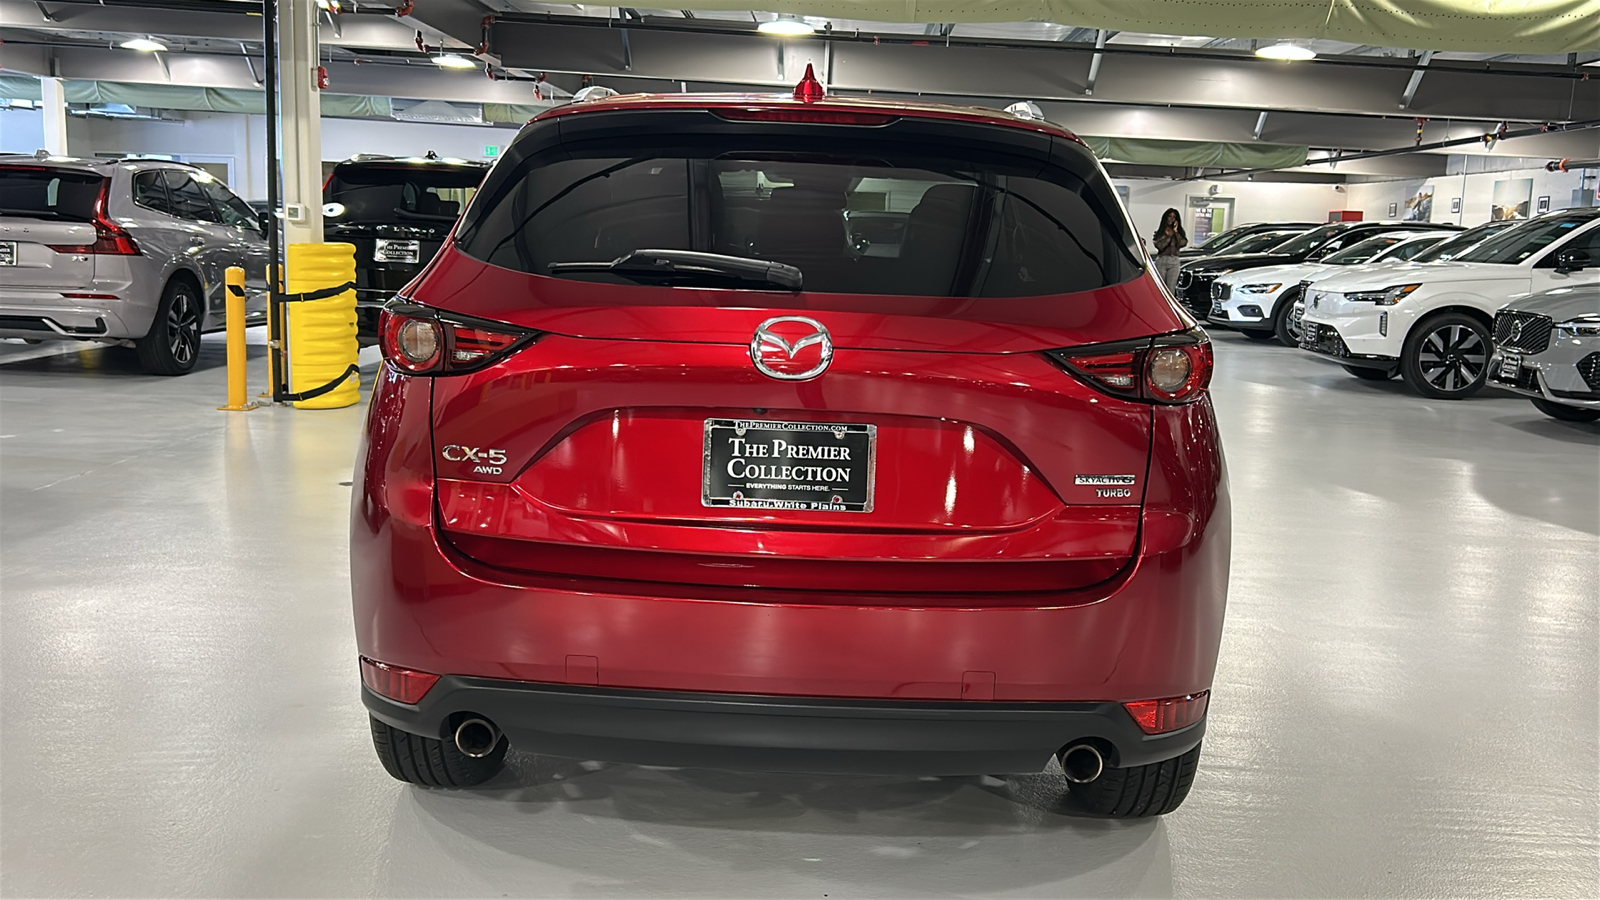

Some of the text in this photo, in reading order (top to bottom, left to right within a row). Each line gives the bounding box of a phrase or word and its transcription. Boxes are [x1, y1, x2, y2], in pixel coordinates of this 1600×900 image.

[442, 445, 507, 465] CX-5
[728, 438, 851, 461] THE PREMIER
[473, 466, 503, 475] AWD
[727, 458, 851, 482] COLLECTION
[1096, 489, 1131, 498] TURBO
[811, 502, 846, 511] Plains
